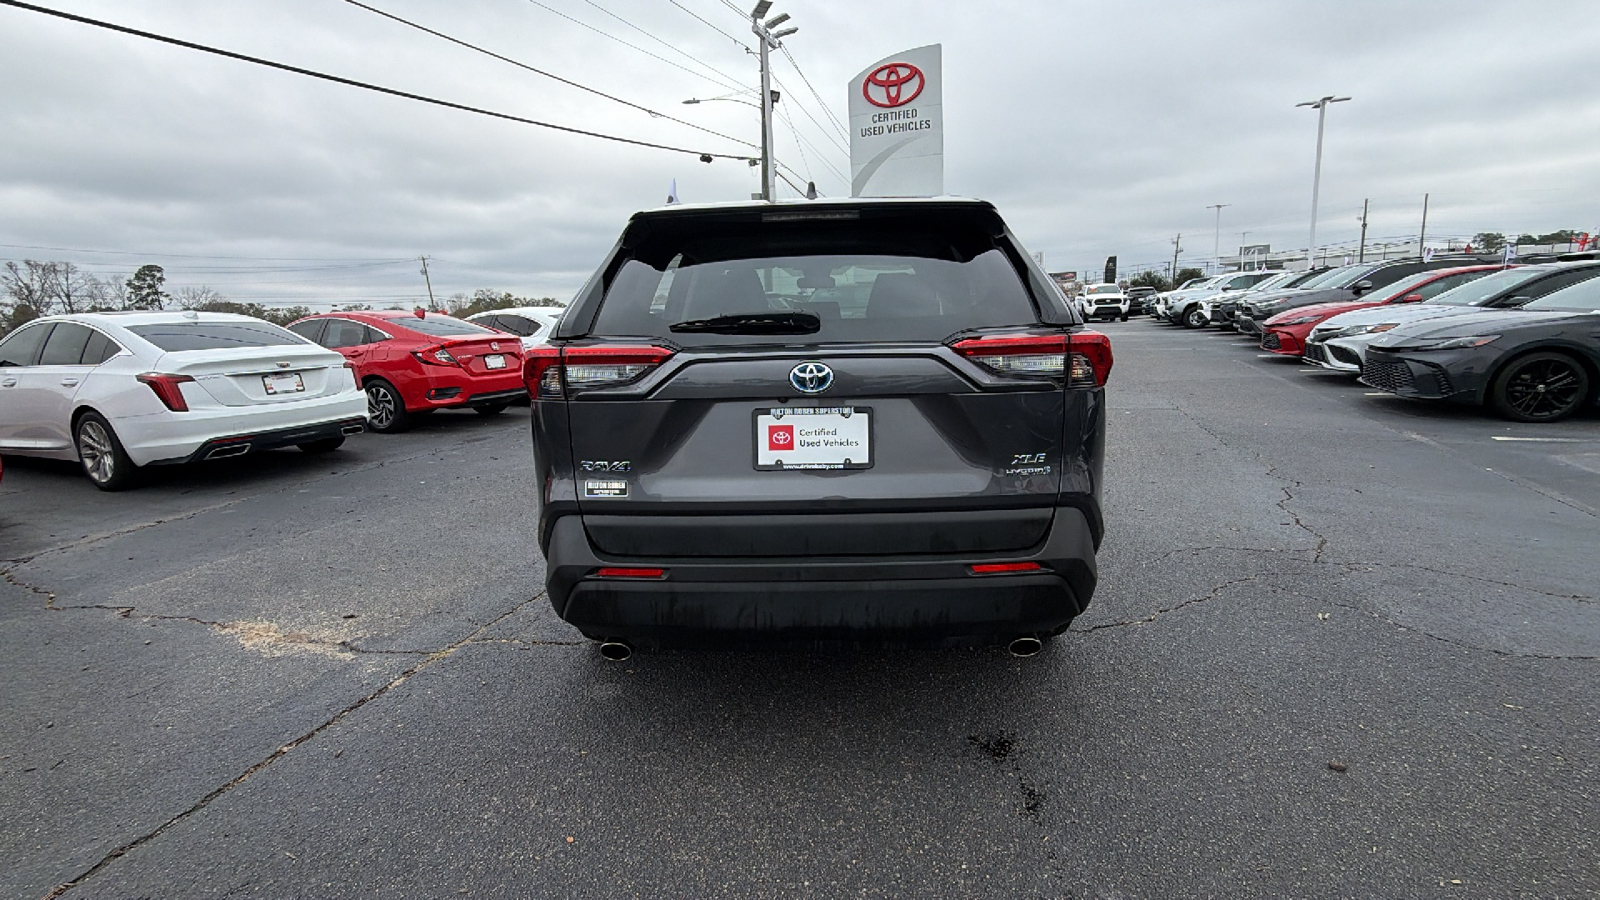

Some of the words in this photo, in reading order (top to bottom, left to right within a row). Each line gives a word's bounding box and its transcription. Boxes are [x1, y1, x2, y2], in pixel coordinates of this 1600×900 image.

[871, 108, 918, 124] CERTIFIED
[860, 124, 885, 138] USED
[886, 119, 931, 135] VEHICLES
[814, 406, 855, 415] SUPERSTORE
[799, 428, 837, 437] Certified
[799, 439, 821, 447] Used
[822, 438, 859, 447] Vehicles
[1011, 453, 1047, 464] XLE
[580, 460, 631, 471] RAV4
